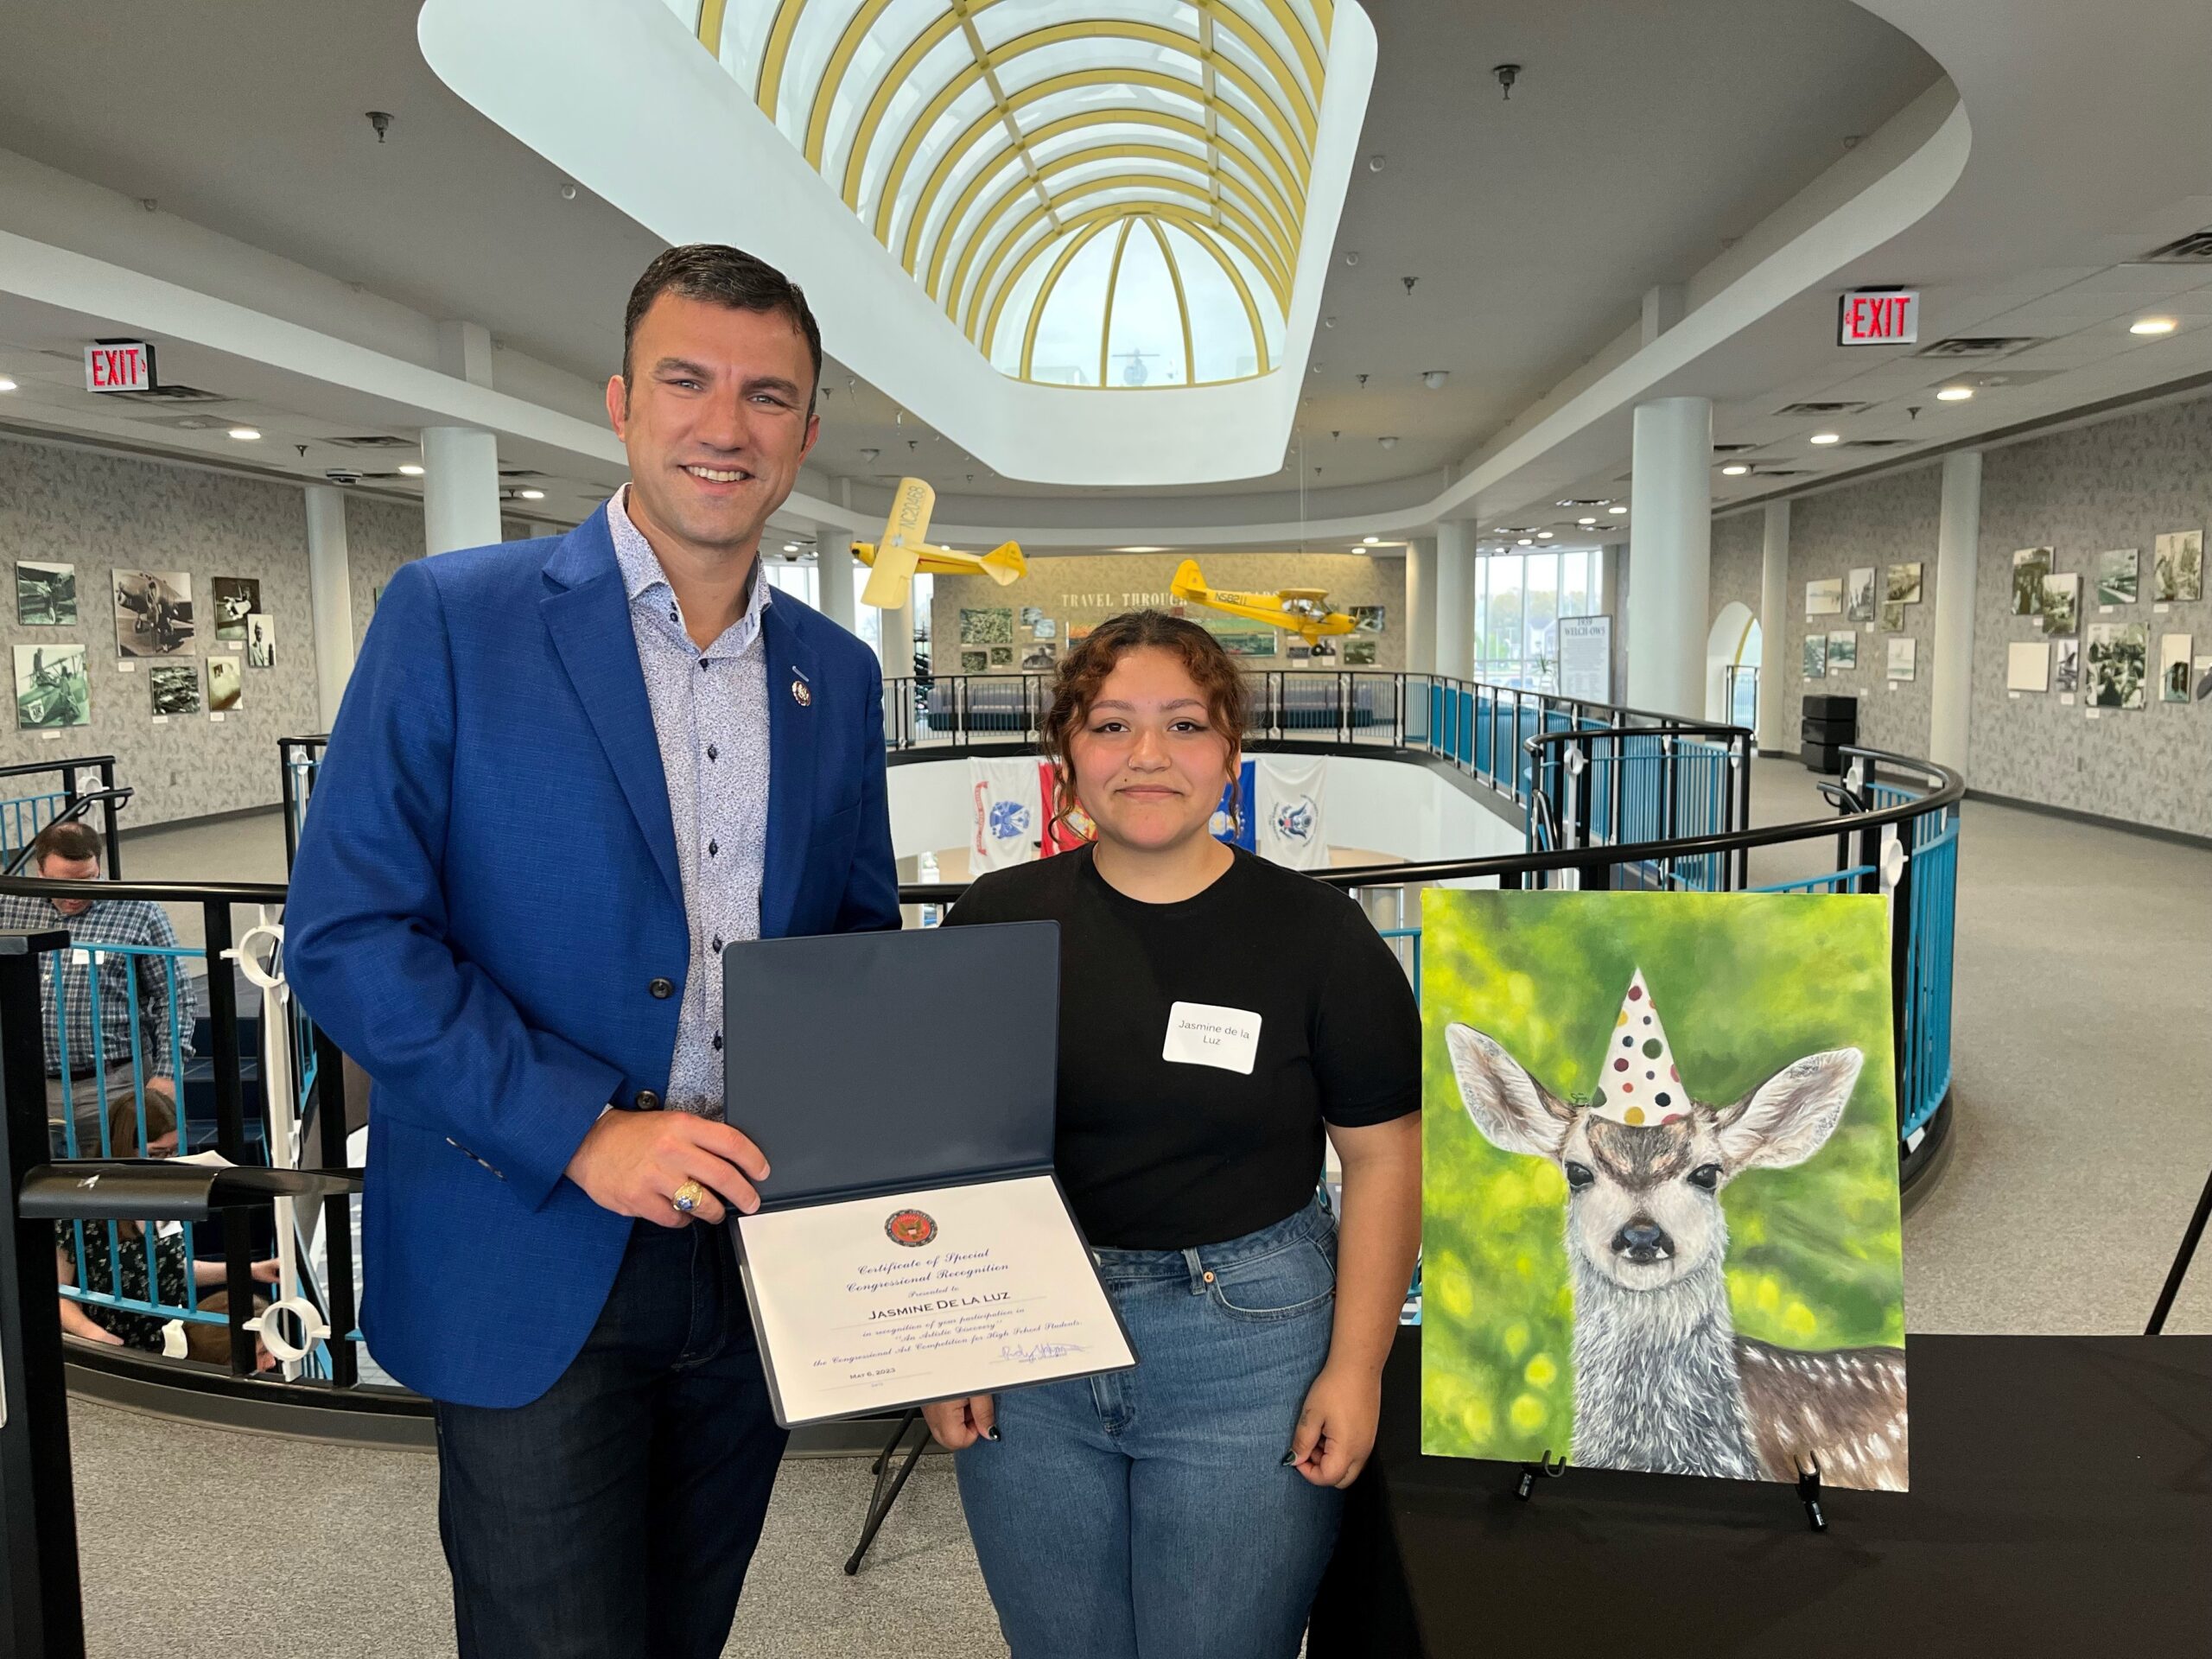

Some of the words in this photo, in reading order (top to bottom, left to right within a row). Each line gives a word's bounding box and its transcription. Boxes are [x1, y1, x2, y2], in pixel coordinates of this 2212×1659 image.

[1852, 297, 1910, 339] EXIT
[92, 349, 139, 386] EXIT
[1061, 593, 1114, 607] TRAVEL
[1179, 1020, 1222, 1033] Jasmine
[1224, 1027, 1237, 1036] de
[1241, 1029, 1249, 1039] la
[1203, 1035, 1222, 1046] Luz
[857, 1259, 921, 1275] Certificate
[925, 1255, 940, 1268] of
[944, 1249, 989, 1264] Special
[846, 1272, 931, 1293] Congressional
[937, 1263, 1009, 1279] Recognition
[908, 1286, 949, 1299] Presented
[868, 1303, 934, 1320] JASMINE
[962, 1296, 981, 1306] LA
[983, 1292, 1012, 1303] LUZ
[875, 1324, 922, 1336] recognition
[925, 1319, 935, 1329] of
[938, 1317, 957, 1328] your
[959, 1310, 1014, 1325] participation
[918, 1328, 952, 1340] Artistic
[812, 1359, 828, 1368] the
[831, 1348, 893, 1364] Congressional
[895, 1346, 912, 1355] Art
[915, 1338, 969, 1351] Competition
[970, 1334, 983, 1344] for
[987, 1330, 1009, 1340] High
[1013, 1324, 1040, 1336] School
[875, 1367, 896, 1376] 2023
